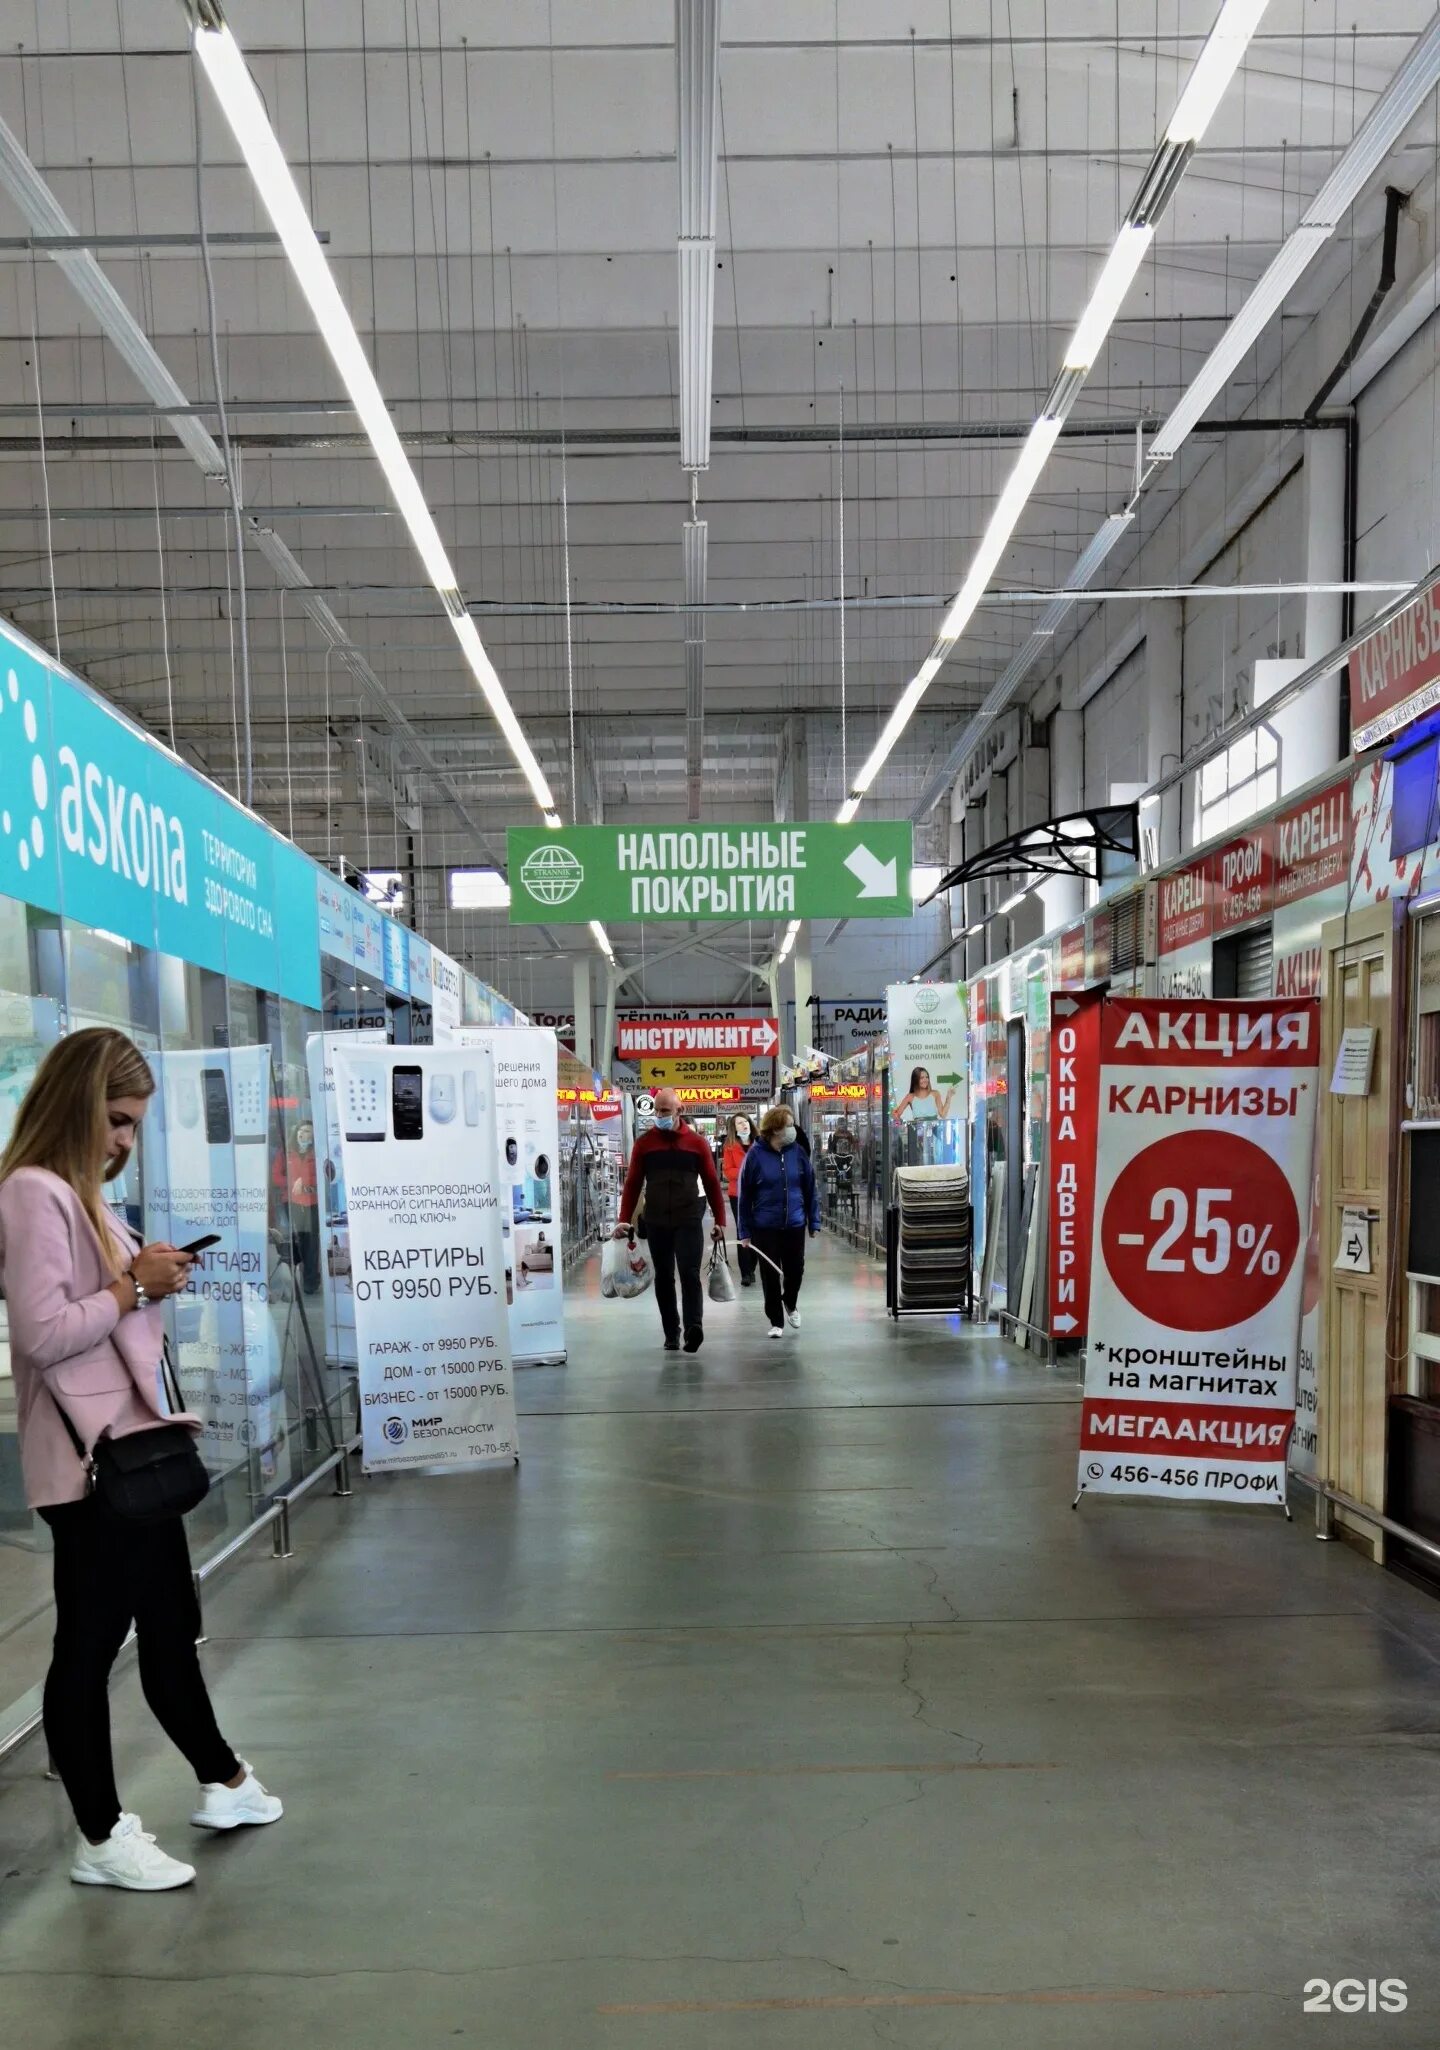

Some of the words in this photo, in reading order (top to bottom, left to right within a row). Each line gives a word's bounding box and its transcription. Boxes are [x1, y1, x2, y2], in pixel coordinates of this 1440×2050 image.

[58, 744, 188, 905] askona
[1279, 791, 1344, 868] KAPELLI
[202, 829, 257, 890] ТЕРРИТОРИЯ
[617, 831, 807, 871] НАПОЛЬНЫЕ
[533, 868, 571, 876] STRANNIK
[1222, 838, 1262, 891] ПРОФИ
[1319, 850, 1343, 880] ДВЕРИ
[631, 874, 796, 914] ПОКРЫТИЯ
[1163, 866, 1205, 920] KAPELLI
[1229, 886, 1262, 920] 456-456
[257, 906, 274, 940] СНА
[1188, 912, 1205, 937] ДВЕРИ
[620, 1026, 751, 1050] ИНСТРУМЕНТ
[1114, 1011, 1310, 1057] АКЦИЯ
[498, 1062, 541, 1074] решения
[675, 1062, 698, 1072] 220
[700, 1061, 737, 1071] ВОЛЬТ
[521, 1078, 547, 1090] дома
[1057, 1027, 1077, 1141] ОКНА
[351, 1185, 399, 1197] МОНТАЖ
[402, 1182, 491, 1197] БЕЗПРОВОДНОЙ
[348, 1198, 406, 1211] ОХРАННОЙ
[409, 1197, 498, 1210] СИГНАЛИЗАЦИИ
[388, 1213, 418, 1225] «ПОД
[420, 1212, 457, 1223] КЛЮЧ»
[1056, 1163, 1078, 1303] ДВЕРИ
[1117, 1187, 1281, 1277] -25%
[364, 1246, 484, 1271] КВАРТИРЫ
[356, 1280, 385, 1301] ОТ
[392, 1277, 442, 1299] 9950
[448, 1275, 498, 1297] РУБ.
[368, 1341, 412, 1355] ГАРАЖ
[422, 1343, 435, 1352] от
[438, 1338, 466, 1350] 9950
[470, 1336, 498, 1348] РУБ.
[384, 1366, 413, 1381] ДОМ
[424, 1367, 436, 1376] от
[441, 1361, 475, 1375] 15000
[478, 1359, 507, 1372] РУБ.
[364, 1391, 416, 1406] БИЗНЕС
[427, 1391, 439, 1400] от
[444, 1386, 477, 1399] 15000
[480, 1384, 509, 1397] РУБ.
[1107, 1371, 1143, 1391] на
[1149, 1373, 1278, 1396] магнитах
[412, 1417, 443, 1428] МИР
[413, 1423, 494, 1439] БЕЗОПАСНОСТИ
[1089, 1413, 1286, 1449] МЕГААКЦИЯ
[468, 1442, 512, 1456] 70-70-55
[1110, 1464, 1199, 1487] 456-456
[1204, 1470, 1279, 1493] ПРОФИ
